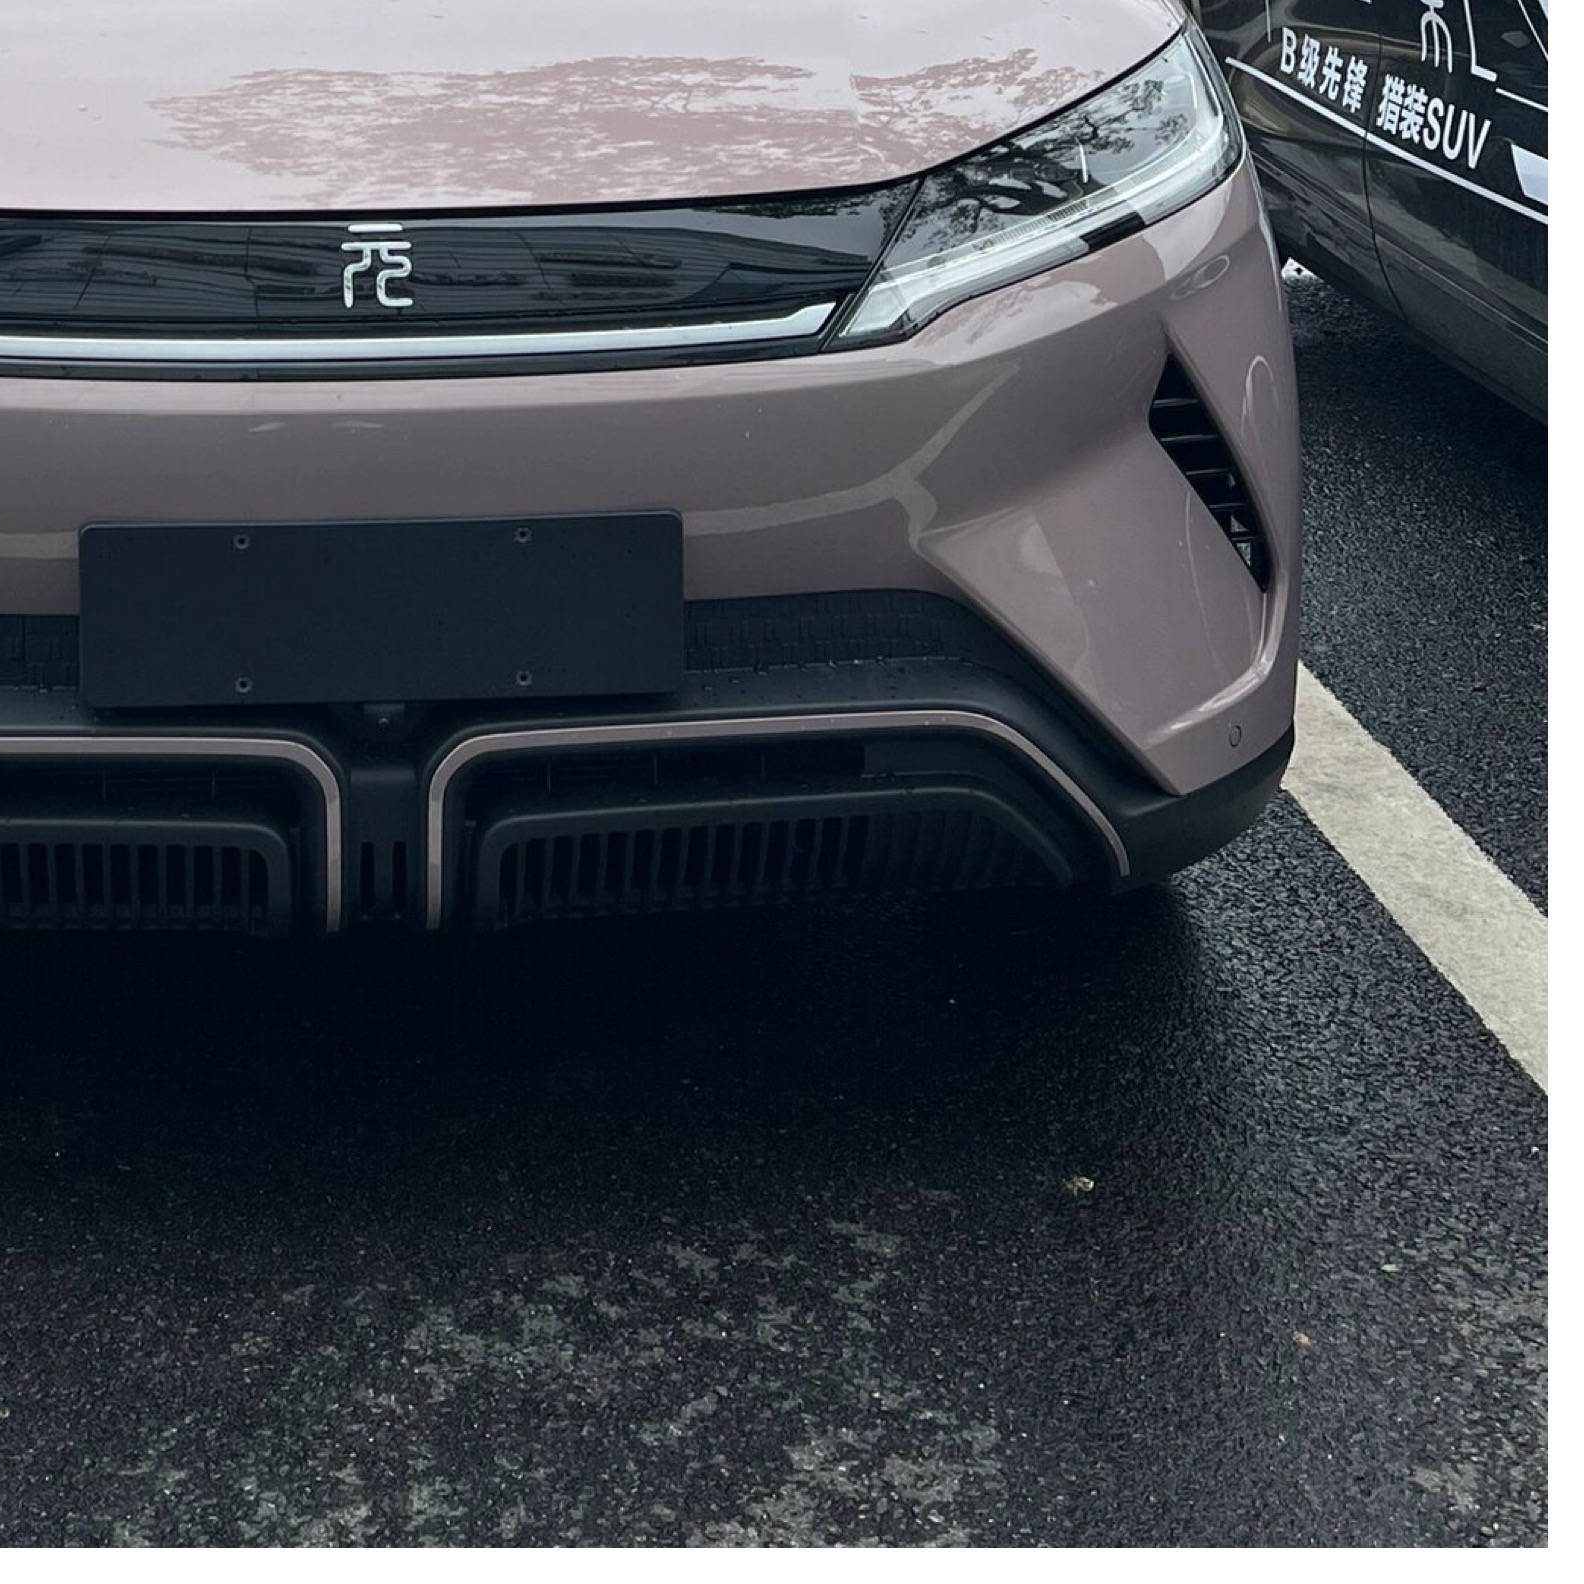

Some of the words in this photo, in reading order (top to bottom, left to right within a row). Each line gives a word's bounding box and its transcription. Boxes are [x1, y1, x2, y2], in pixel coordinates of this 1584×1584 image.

[1280, 27, 1369, 113] B级先锋
[1376, 73, 1492, 170] 猎装SUV
